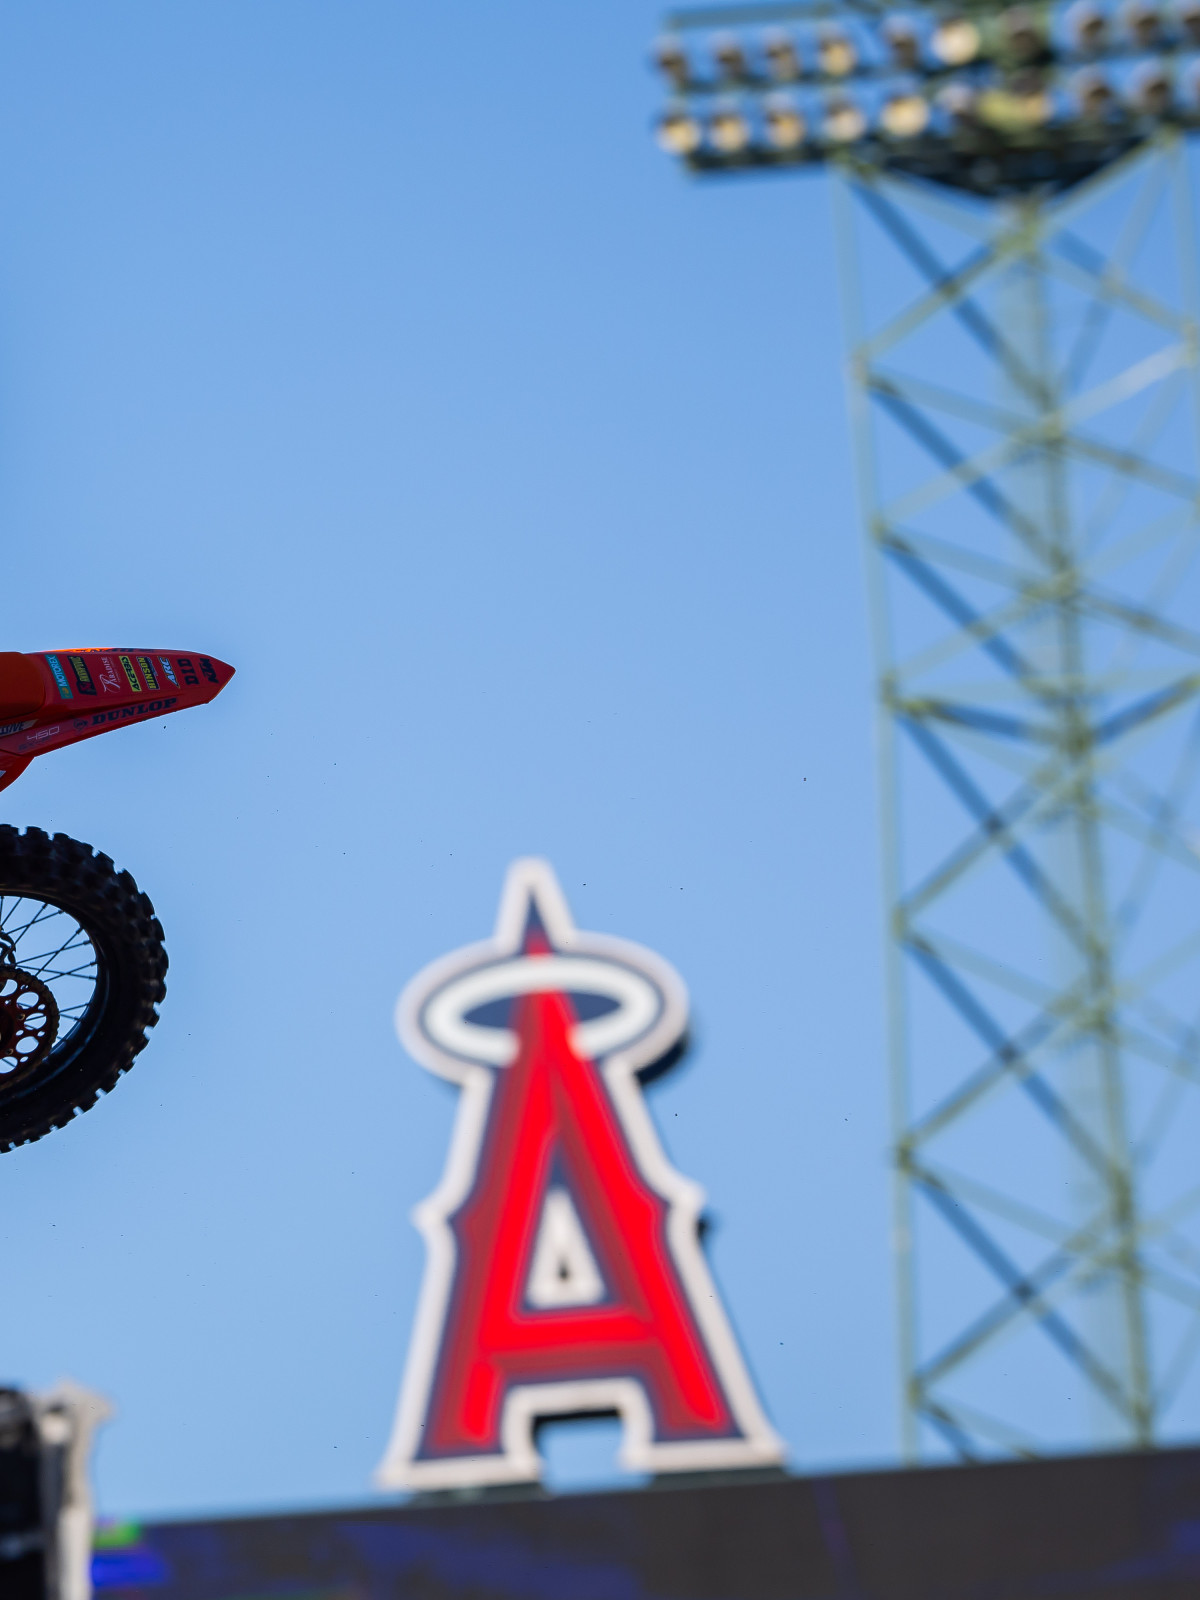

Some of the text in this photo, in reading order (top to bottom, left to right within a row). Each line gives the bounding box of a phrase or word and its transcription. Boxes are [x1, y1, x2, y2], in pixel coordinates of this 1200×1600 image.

[48, 655, 67, 687] MOTOREX
[138, 657, 158, 689] HINSON
[158, 657, 179, 686] ARC
[91, 697, 177, 725] DUNLOP
[27, 725, 60, 740] 450
